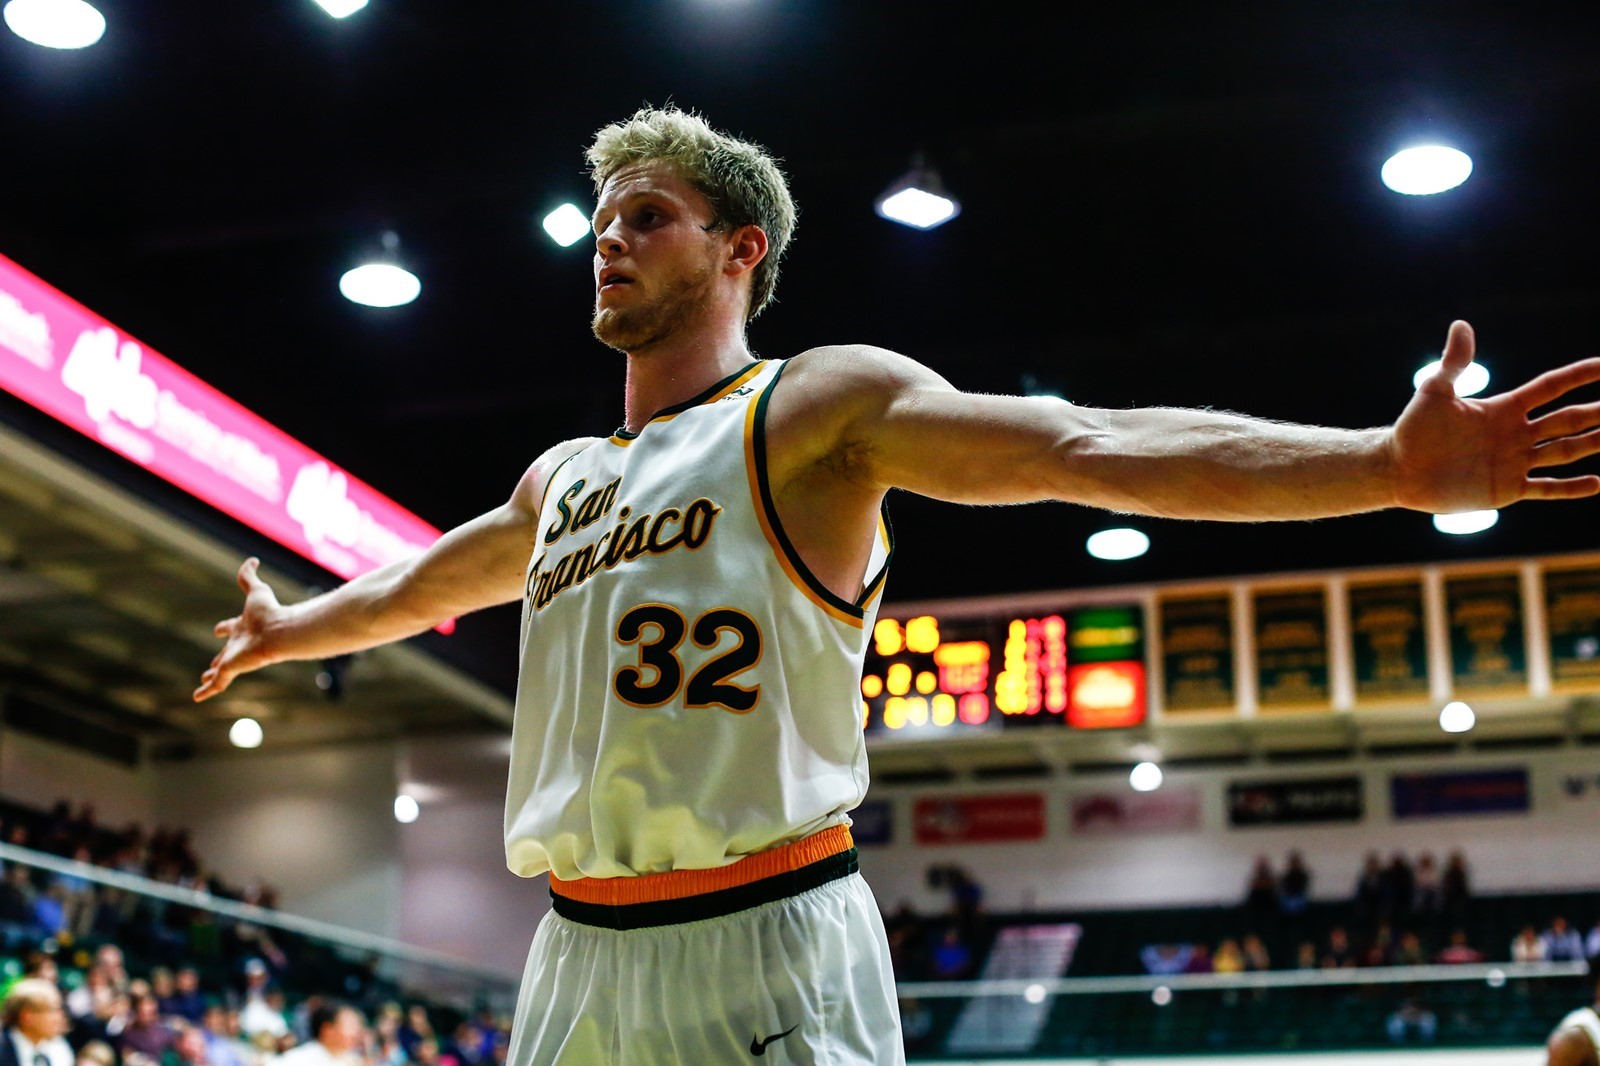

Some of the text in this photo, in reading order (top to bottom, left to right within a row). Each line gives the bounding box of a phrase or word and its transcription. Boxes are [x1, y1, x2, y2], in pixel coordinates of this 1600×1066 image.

[526, 497, 723, 622] Francisco
[544, 476, 624, 546] San
[612, 602, 764, 715] 32
